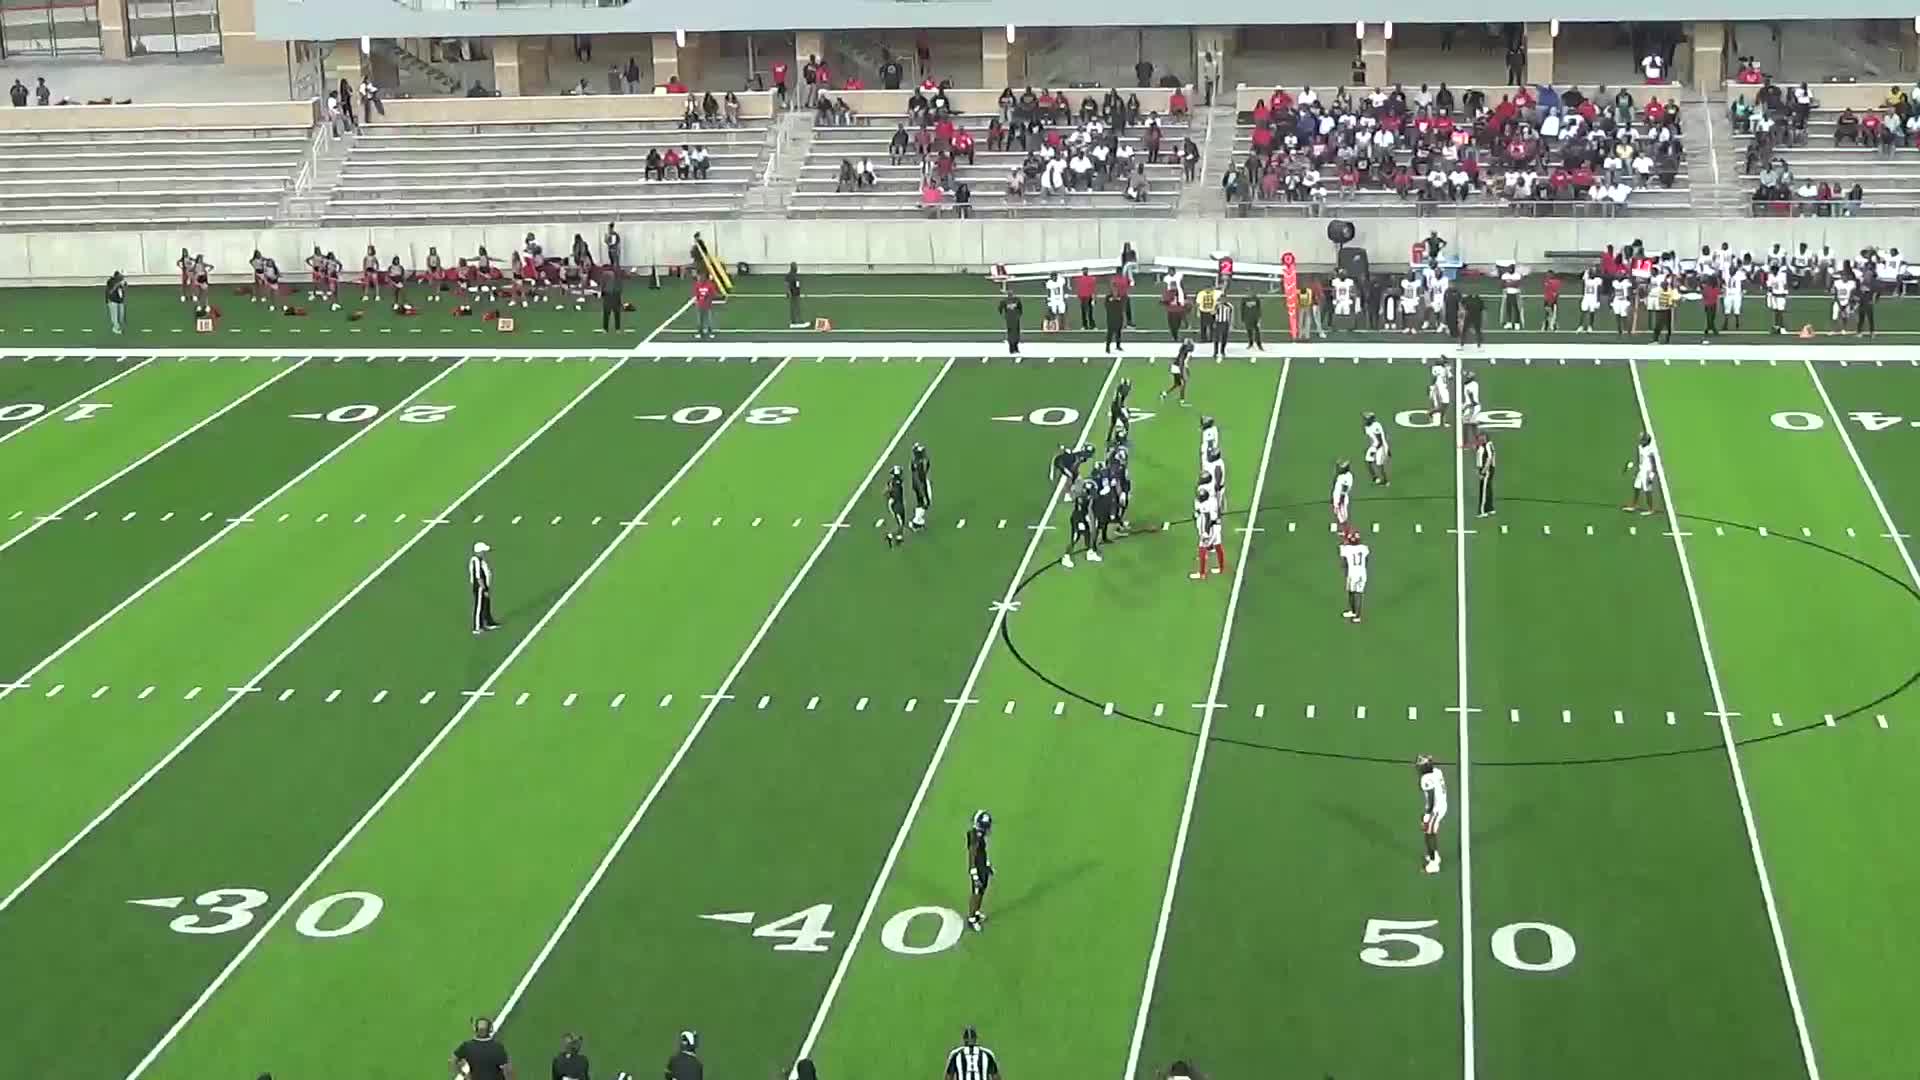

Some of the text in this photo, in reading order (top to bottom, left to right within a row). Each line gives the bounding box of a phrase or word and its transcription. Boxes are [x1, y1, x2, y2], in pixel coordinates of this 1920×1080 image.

[1220, 262, 1230, 273] 2
[170, 888, 384, 937] 30
[753, 903, 964, 954] 40
[1360, 918, 1577, 971] 50
